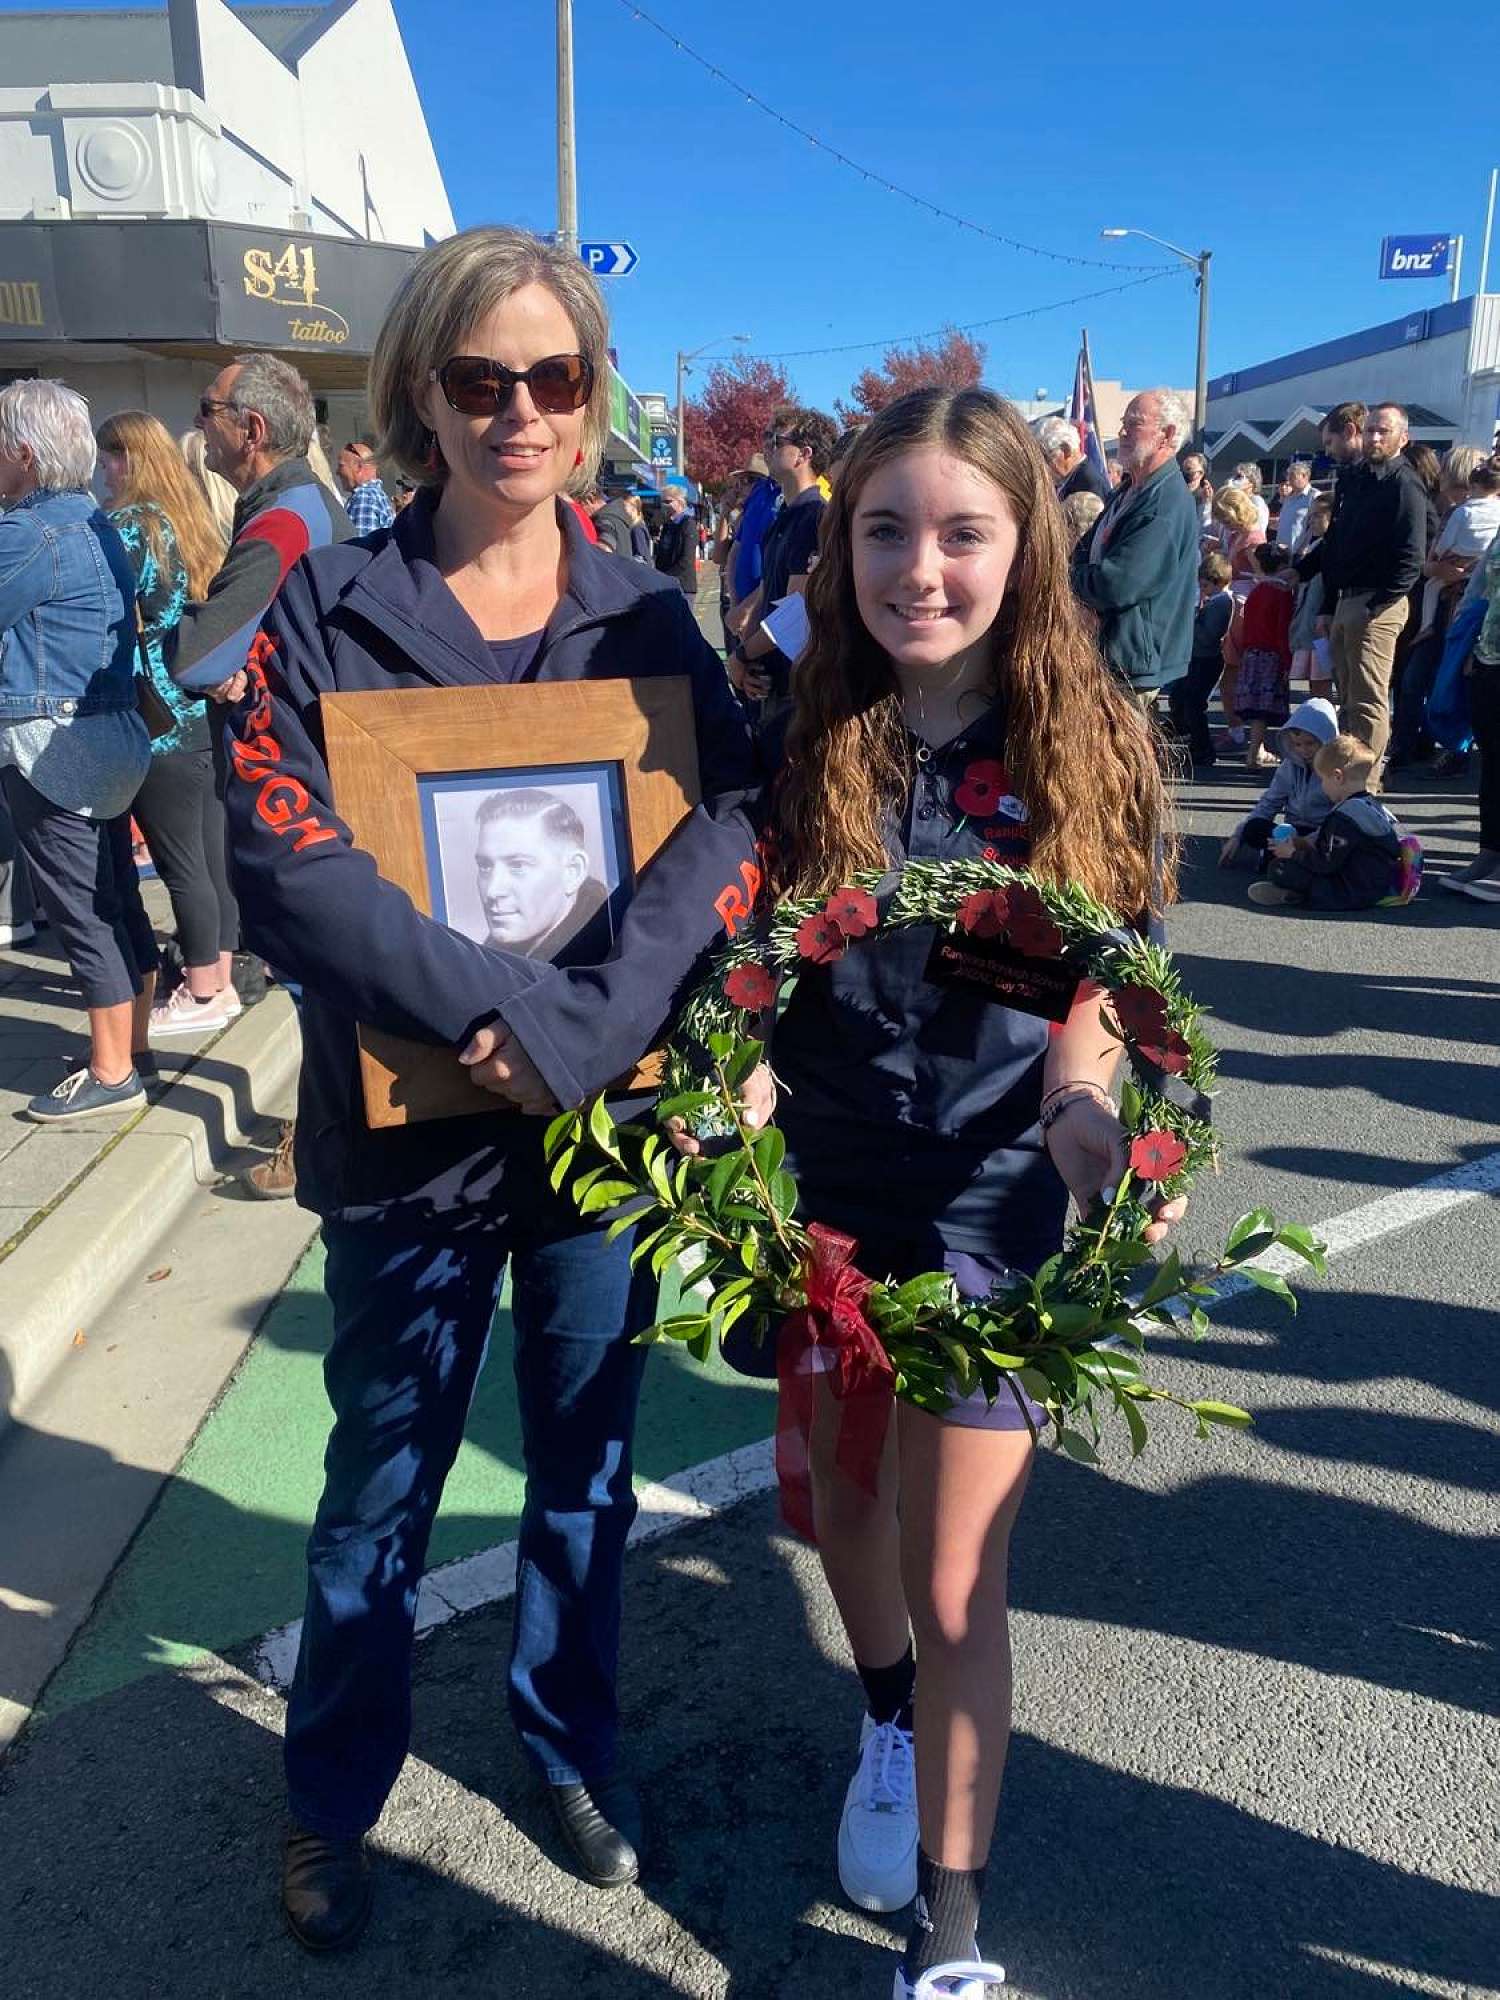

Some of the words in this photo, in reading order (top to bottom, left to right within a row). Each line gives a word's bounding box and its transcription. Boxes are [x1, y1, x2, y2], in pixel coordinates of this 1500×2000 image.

[589, 248, 604, 270] P
[1392, 248, 1433, 270] bnz
[287, 318, 347, 343] tattoo
